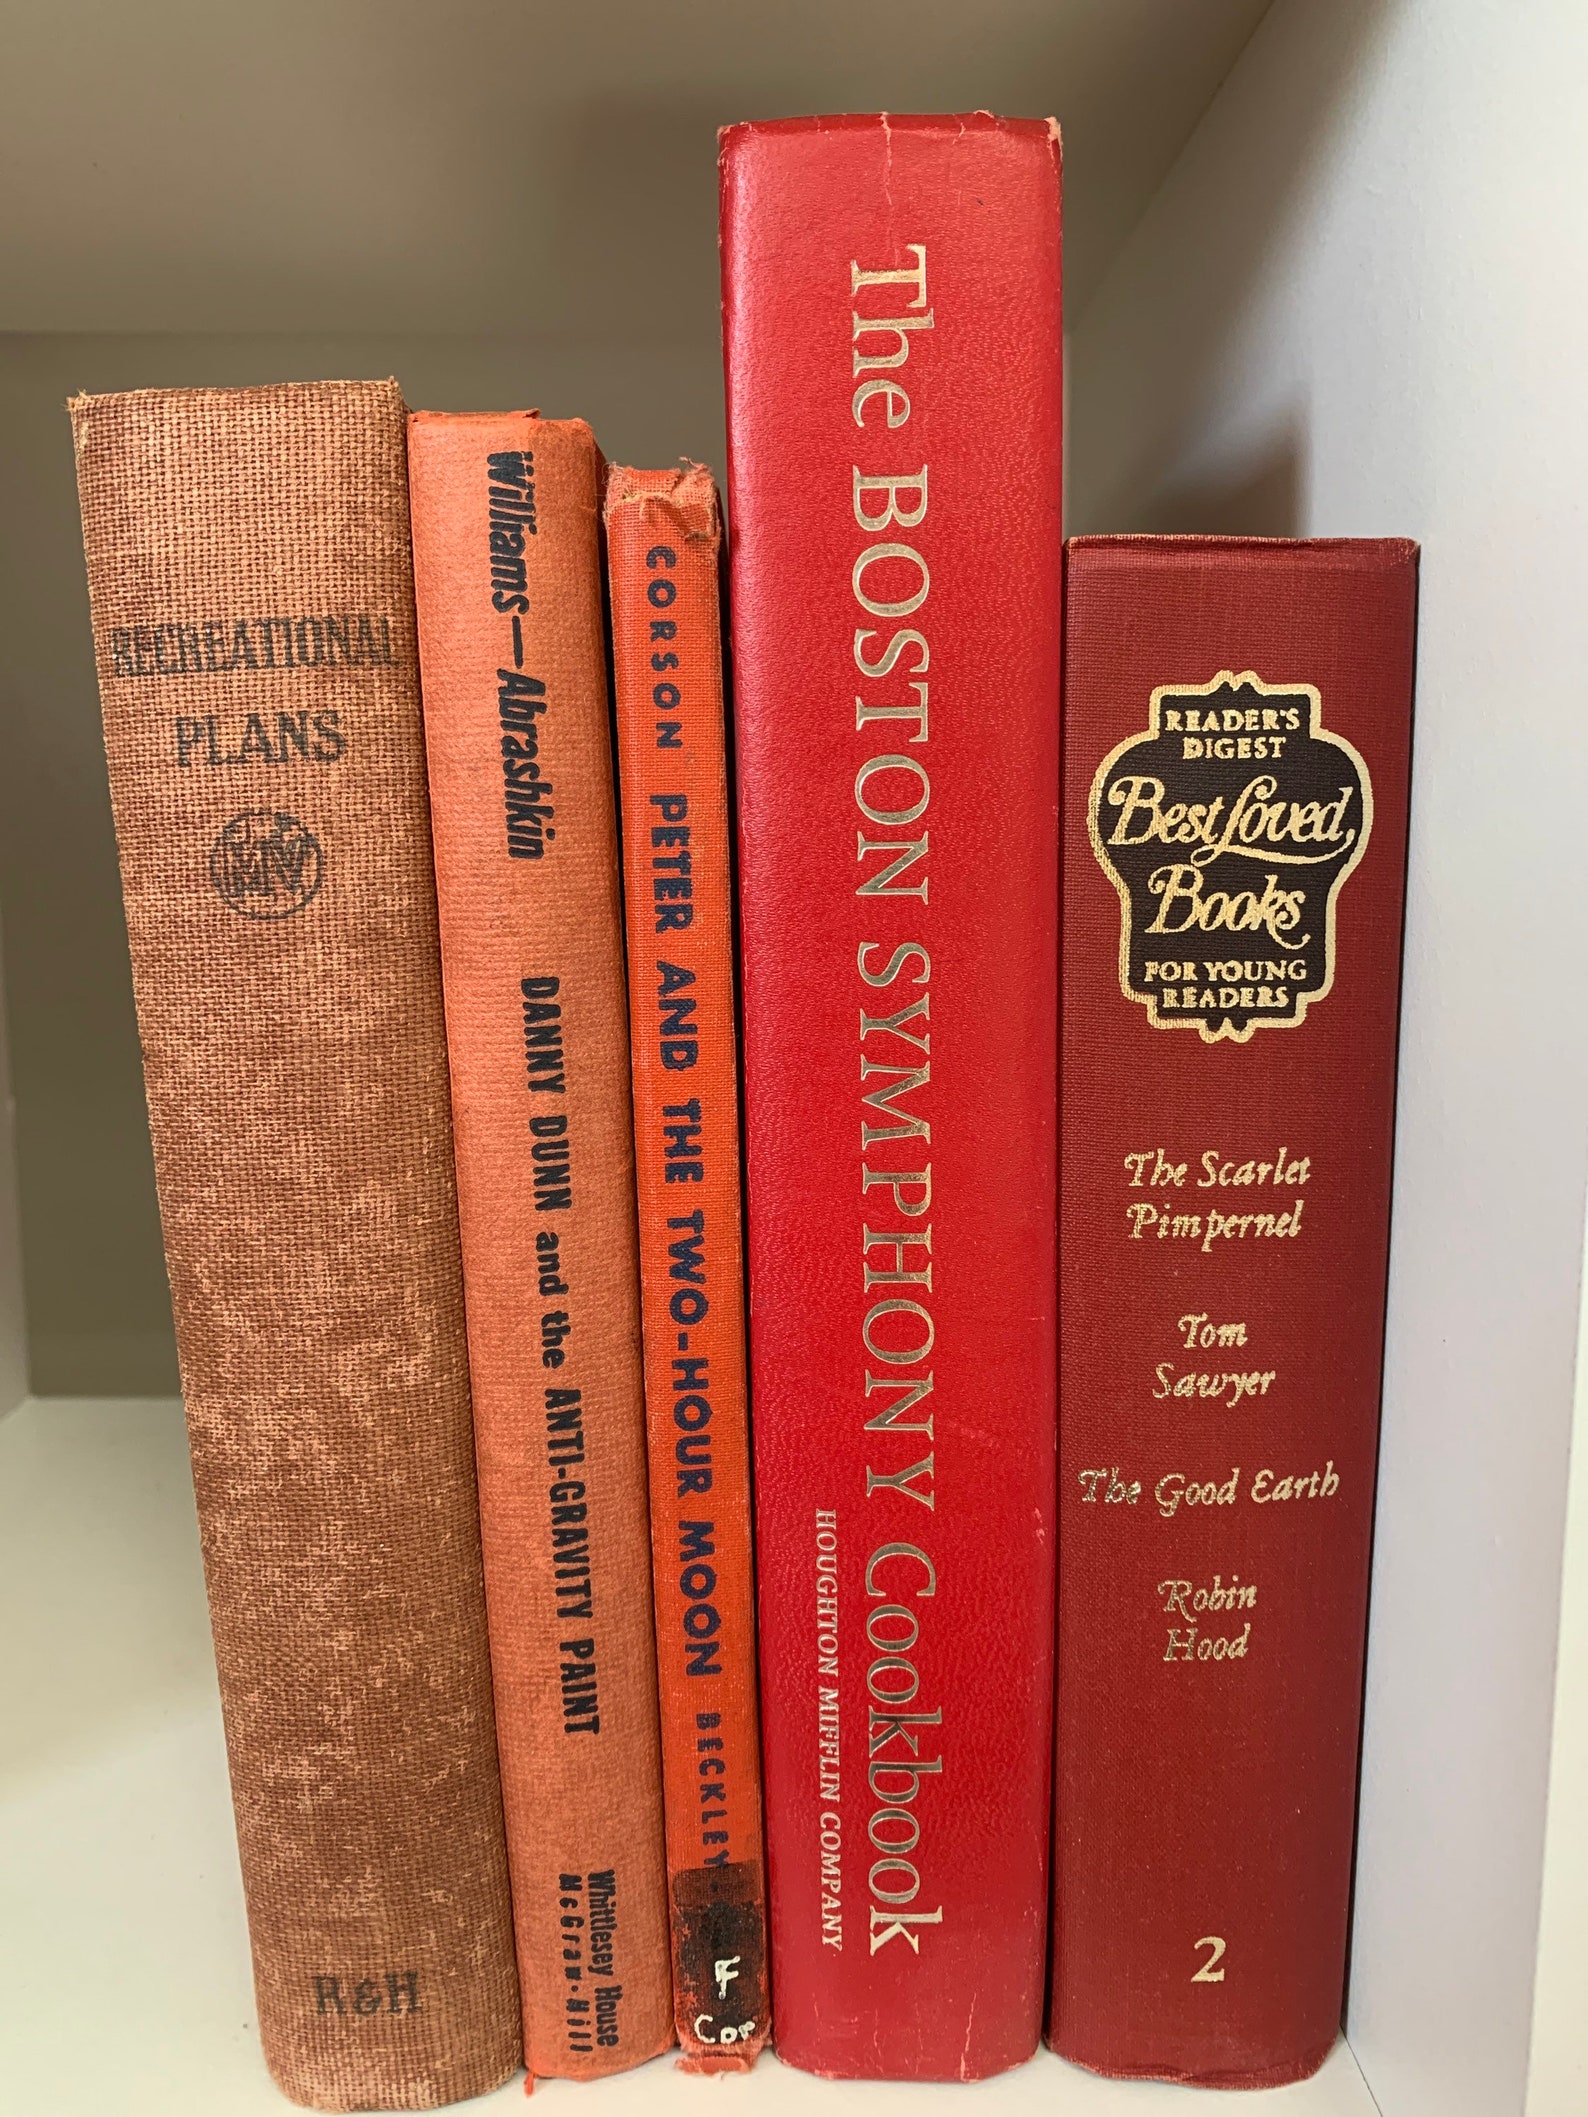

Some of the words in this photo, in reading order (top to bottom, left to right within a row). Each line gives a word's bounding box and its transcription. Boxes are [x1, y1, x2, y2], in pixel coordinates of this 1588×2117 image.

[850, 244, 935, 430] The
[111, 613, 400, 678] RECREATIONAL
[646, 545, 683, 749] CORSON
[851, 464, 930, 905] BOSTON
[174, 708, 348, 768] PLANS
[1164, 707, 1300, 732] READER'S
[1182, 736, 1287, 760] DIGEST
[649, 794, 694, 934] PETER
[1106, 775, 1226, 845] Best
[1191, 774, 1357, 867] Loved
[1144, 863, 1311, 950] Books
[1143, 960, 1199, 983] FOR
[1203, 959, 1308, 982] YOUNG
[1161, 986, 1290, 1009] READERS
[520, 976, 566, 1094] DANNY
[656, 960, 699, 1072] AND
[529, 1115, 573, 1212] DUNN
[662, 1098, 705, 1185] THE
[1123, 1148, 1188, 1187] The
[1196, 1146, 1311, 1187] Scarlet
[534, 1231, 569, 1297] and
[857, 942, 936, 1512] SYMPHONY
[1125, 1199, 1305, 1252] Pimpernel
[540, 1310, 572, 1370] the
[666, 1210, 714, 1498] TWO-HOUR
[1177, 1312, 1248, 1349] Tom
[1152, 1361, 1276, 1408] Sawyer
[544, 1388, 594, 1619] ANTI-GRAVITY
[1077, 1466, 1142, 1504] The
[1154, 1467, 1240, 1517] Good
[1250, 1460, 1340, 1503] Earth
[678, 1520, 723, 1677] MOON
[814, 1508, 841, 1677] HOUGHTON
[1157, 1575, 1258, 1623] Robin
[1162, 1622, 1252, 1662] Hood
[559, 1637, 601, 1736] PAINT
[818, 1684, 842, 1803] MIFFLIN
[865, 1541, 943, 1957] Cookbook
[696, 1712, 730, 1868] BECKLEY
[587, 1869, 618, 1977] Whittlesey
[820, 1811, 843, 1954] COMPANY
[312, 1968, 423, 2017] R&H
[714, 1955, 741, 2000] F
[1190, 1936, 1227, 1983] 2
[594, 1984, 623, 2047] House
